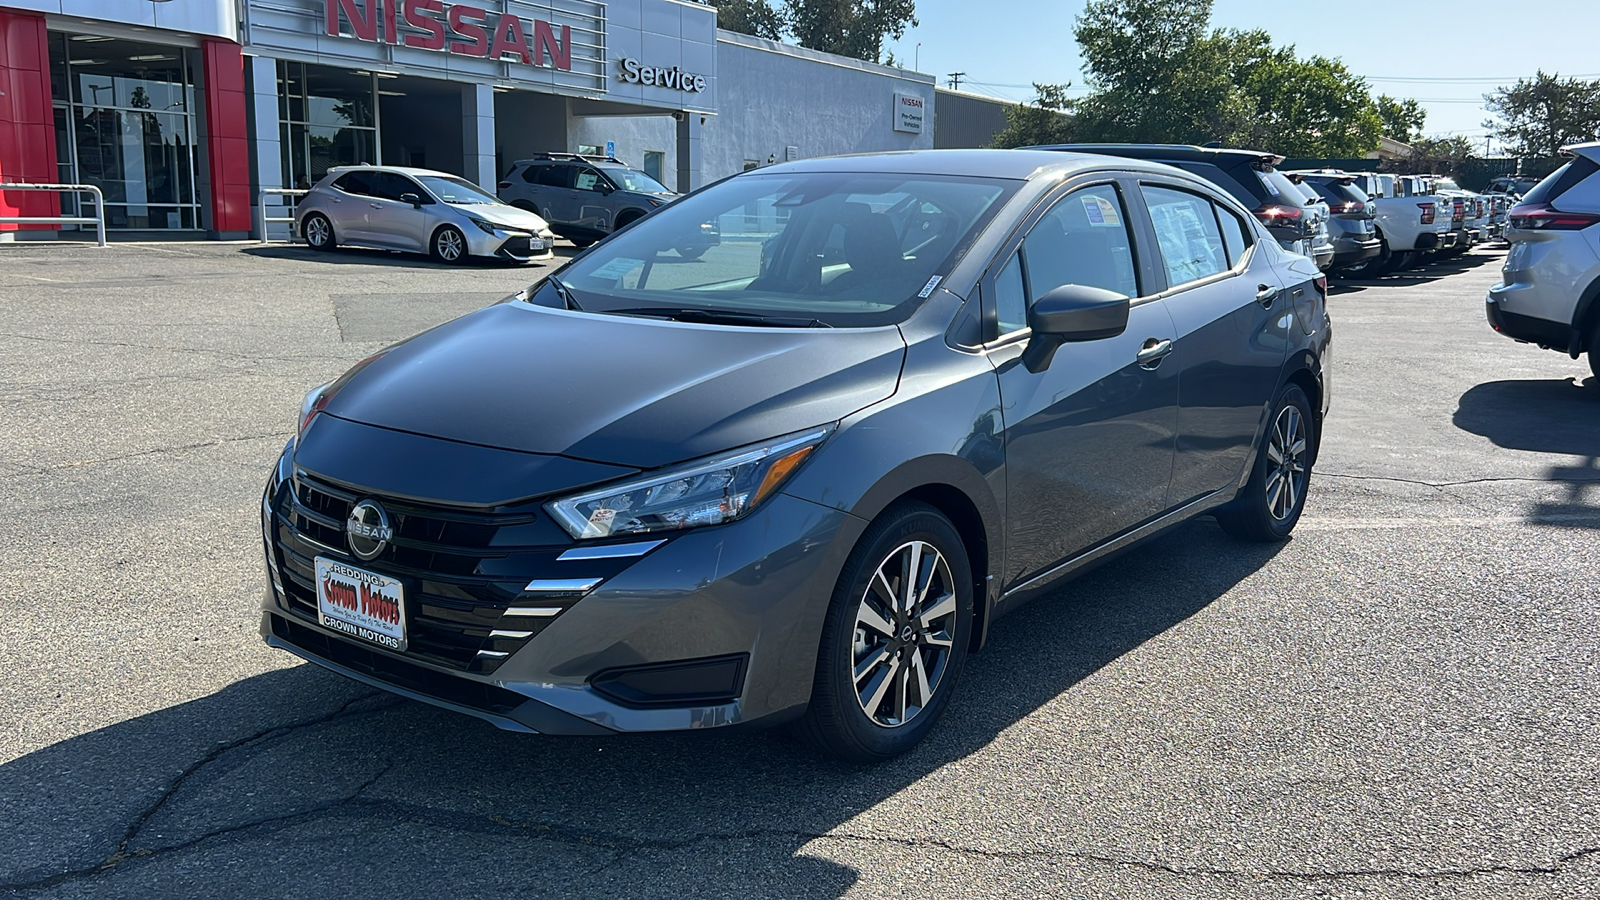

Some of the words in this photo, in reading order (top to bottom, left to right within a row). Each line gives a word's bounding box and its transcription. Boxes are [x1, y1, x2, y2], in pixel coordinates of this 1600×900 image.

[326, 0, 572, 71] NISSAN
[620, 57, 707, 94] Service
[901, 97, 923, 108] NISSAN
[347, 519, 391, 540] NISSAN
[333, 564, 380, 586] REDDING
[323, 577, 358, 612] Crown
[360, 580, 400, 625] Motors
[324, 616, 357, 635] CROWN
[359, 627, 398, 648] MOTORS
